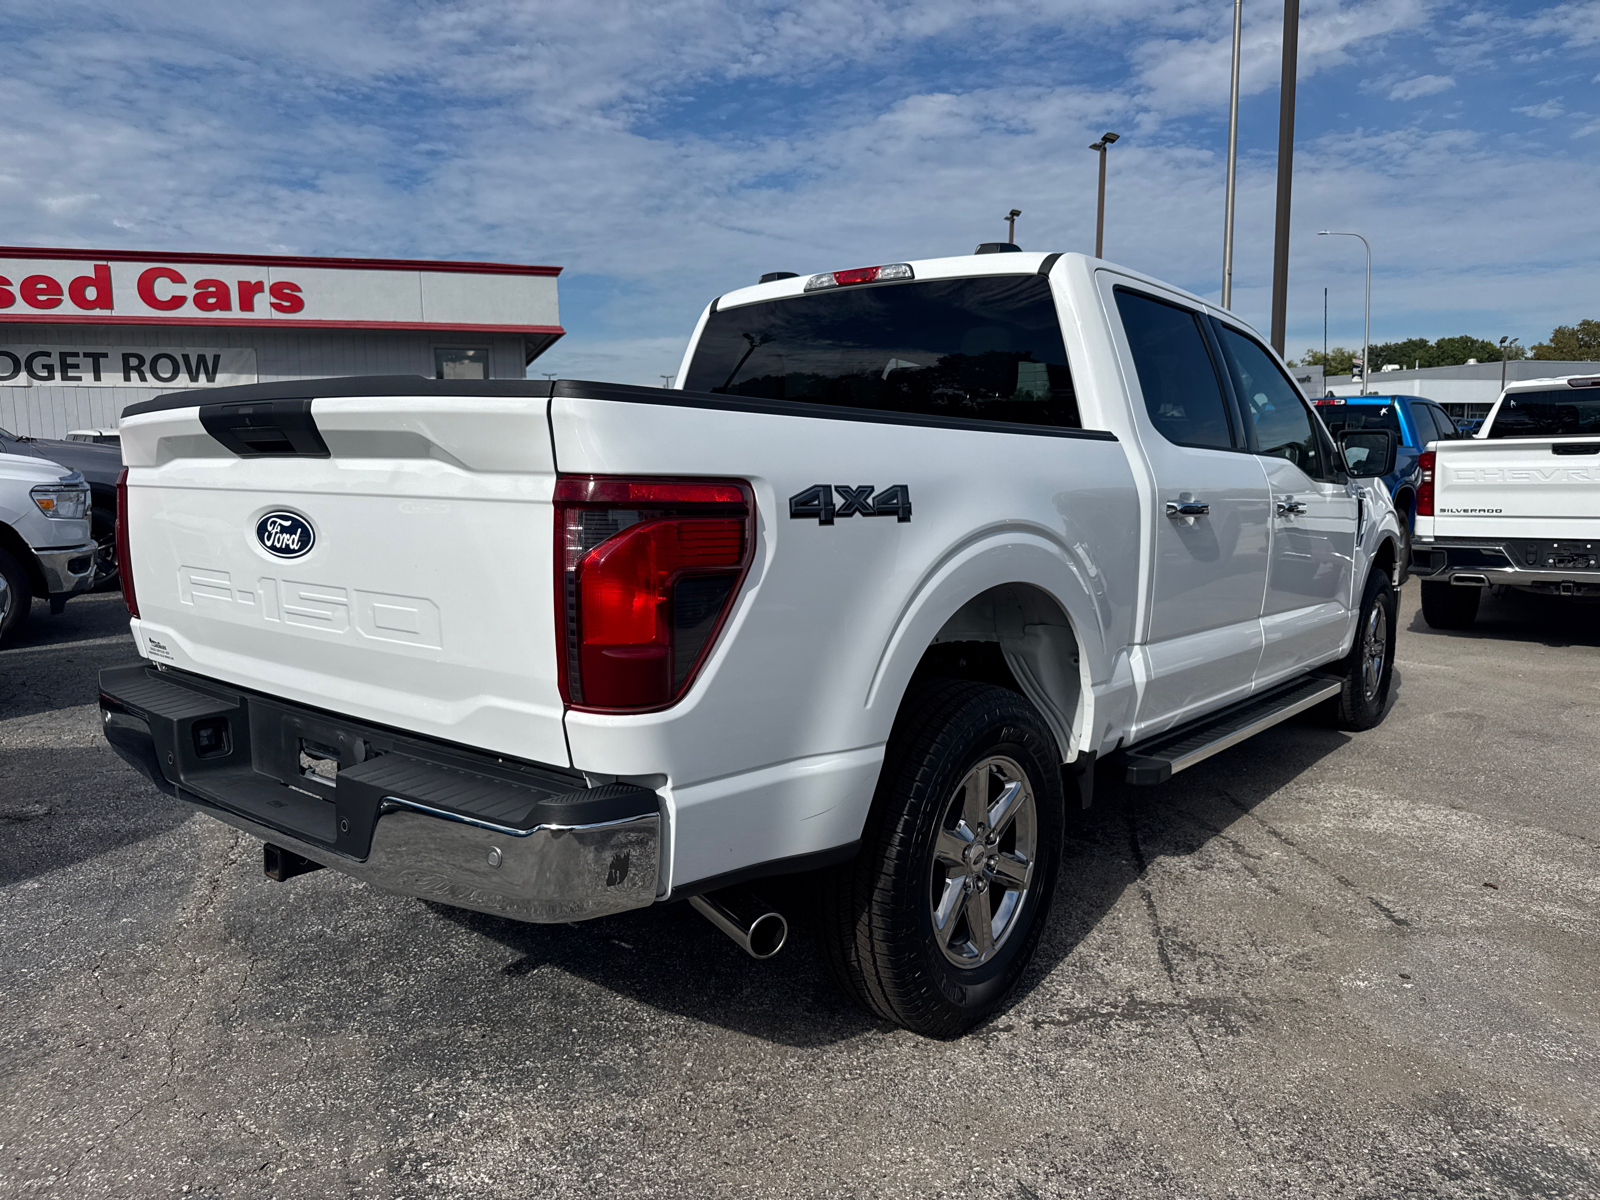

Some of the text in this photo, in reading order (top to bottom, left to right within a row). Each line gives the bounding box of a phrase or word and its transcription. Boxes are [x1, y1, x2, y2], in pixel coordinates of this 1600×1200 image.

[136, 266, 305, 314] Cars
[121, 352, 221, 383] ROW
[1452, 468, 1600, 483] CHEVR
[177, 564, 443, 650] F-150
